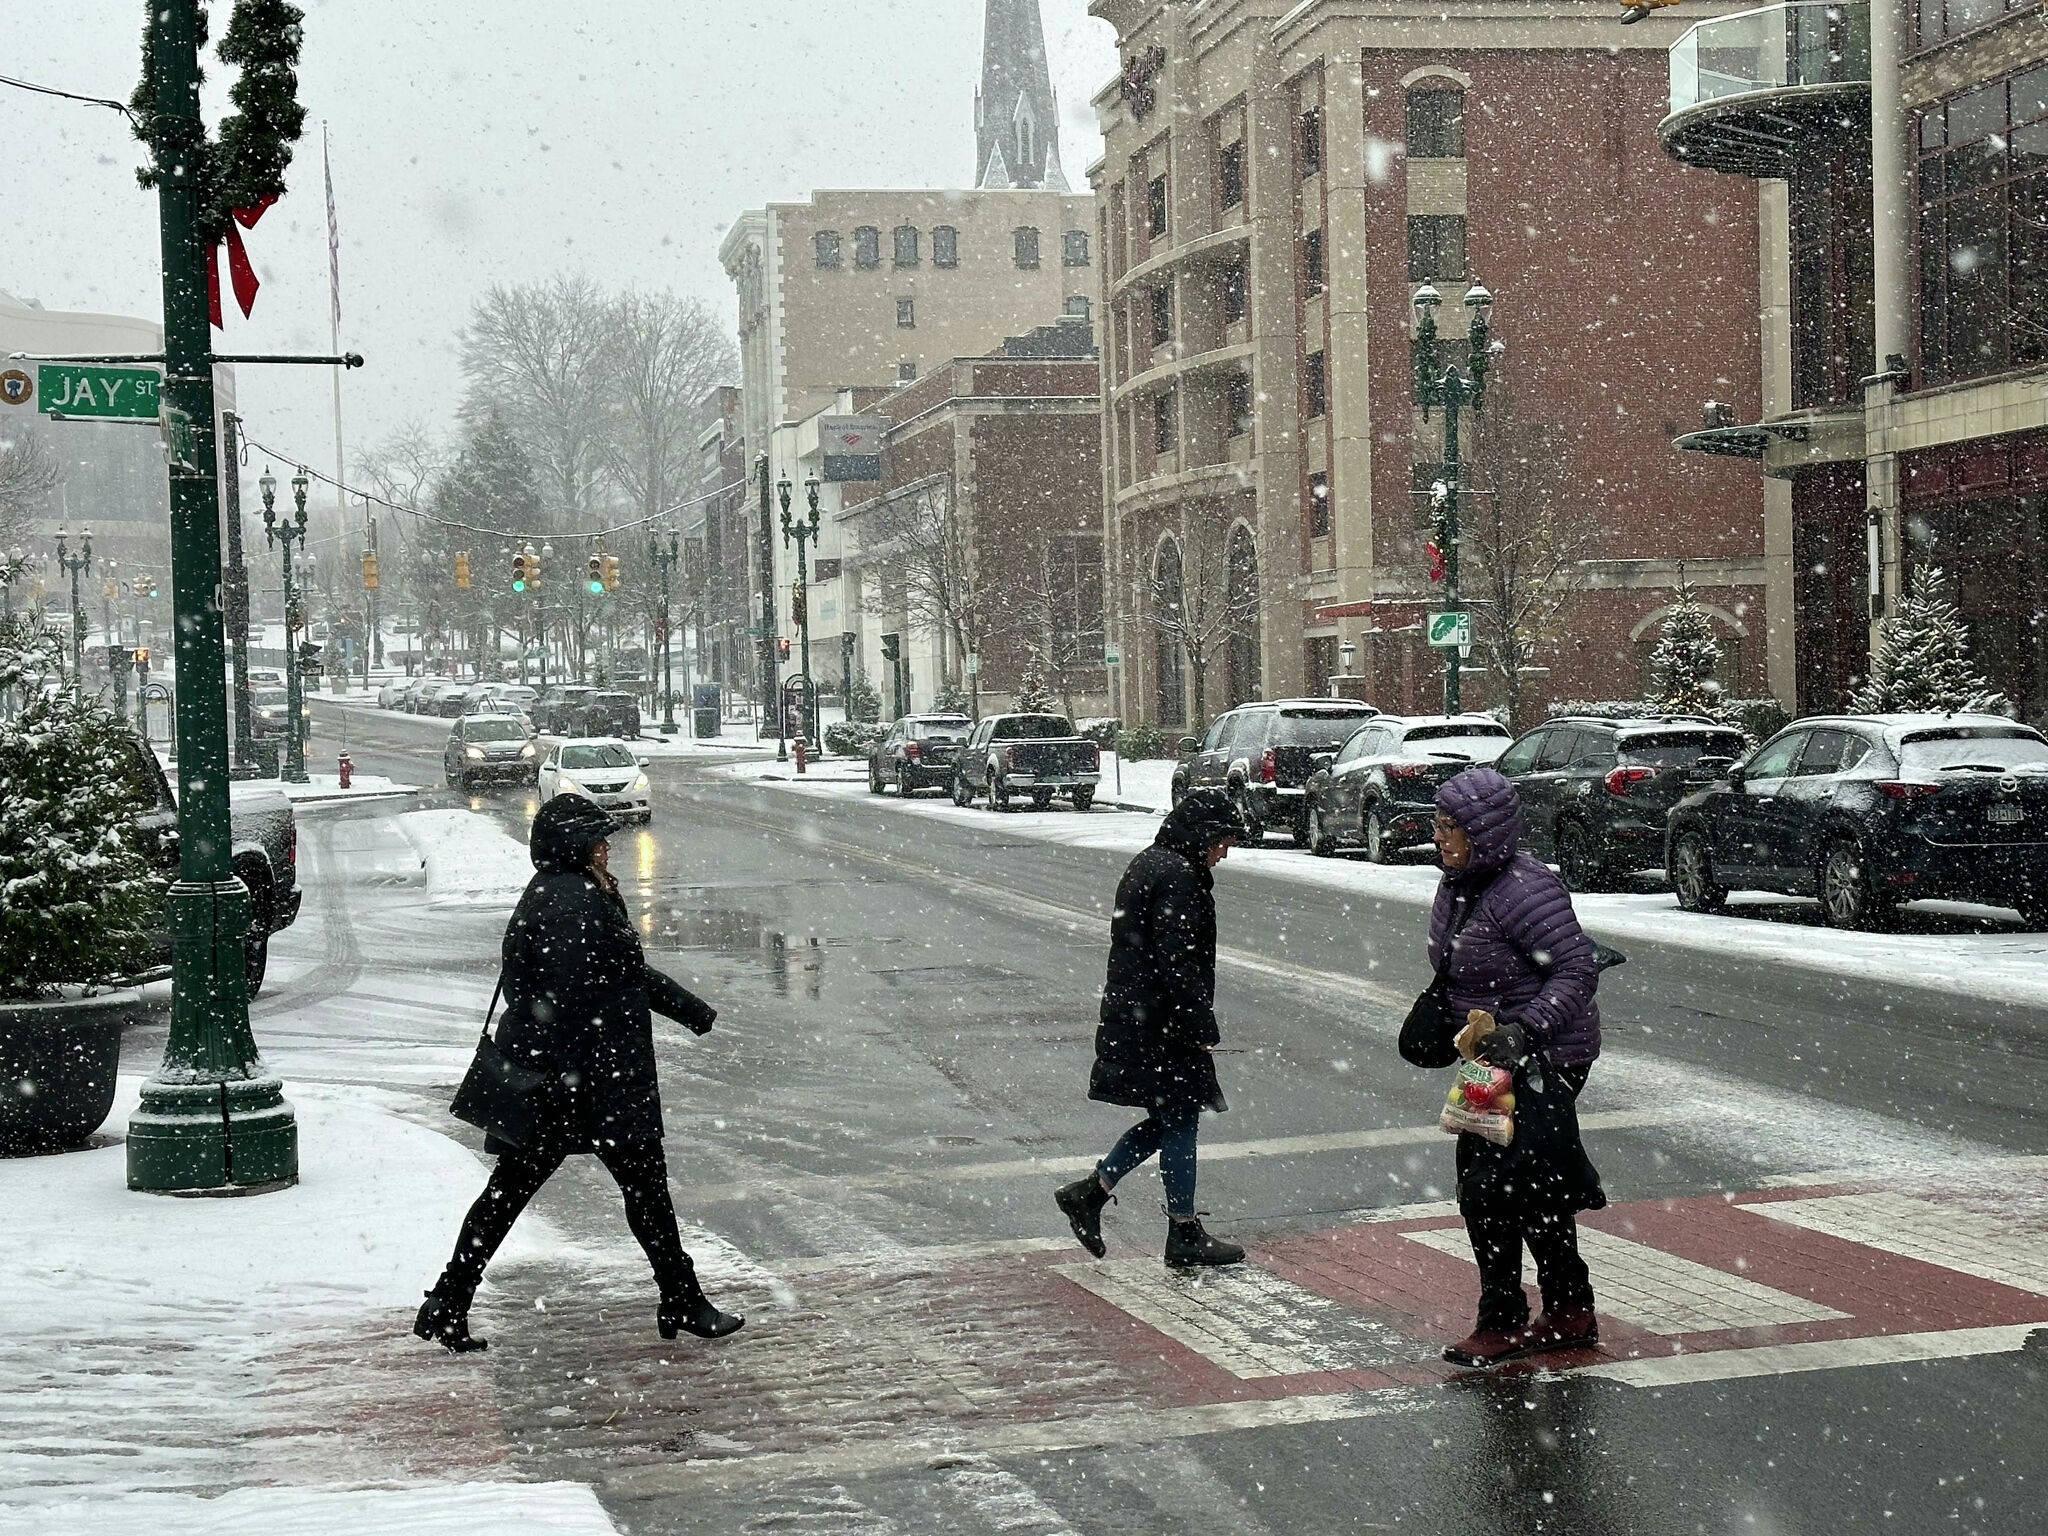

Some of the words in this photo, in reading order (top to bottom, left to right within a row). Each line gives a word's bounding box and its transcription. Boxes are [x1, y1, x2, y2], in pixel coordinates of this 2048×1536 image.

[52, 376, 123, 407] JAY
[135, 380, 154, 396] ST
[1459, 614, 1468, 626] 2
